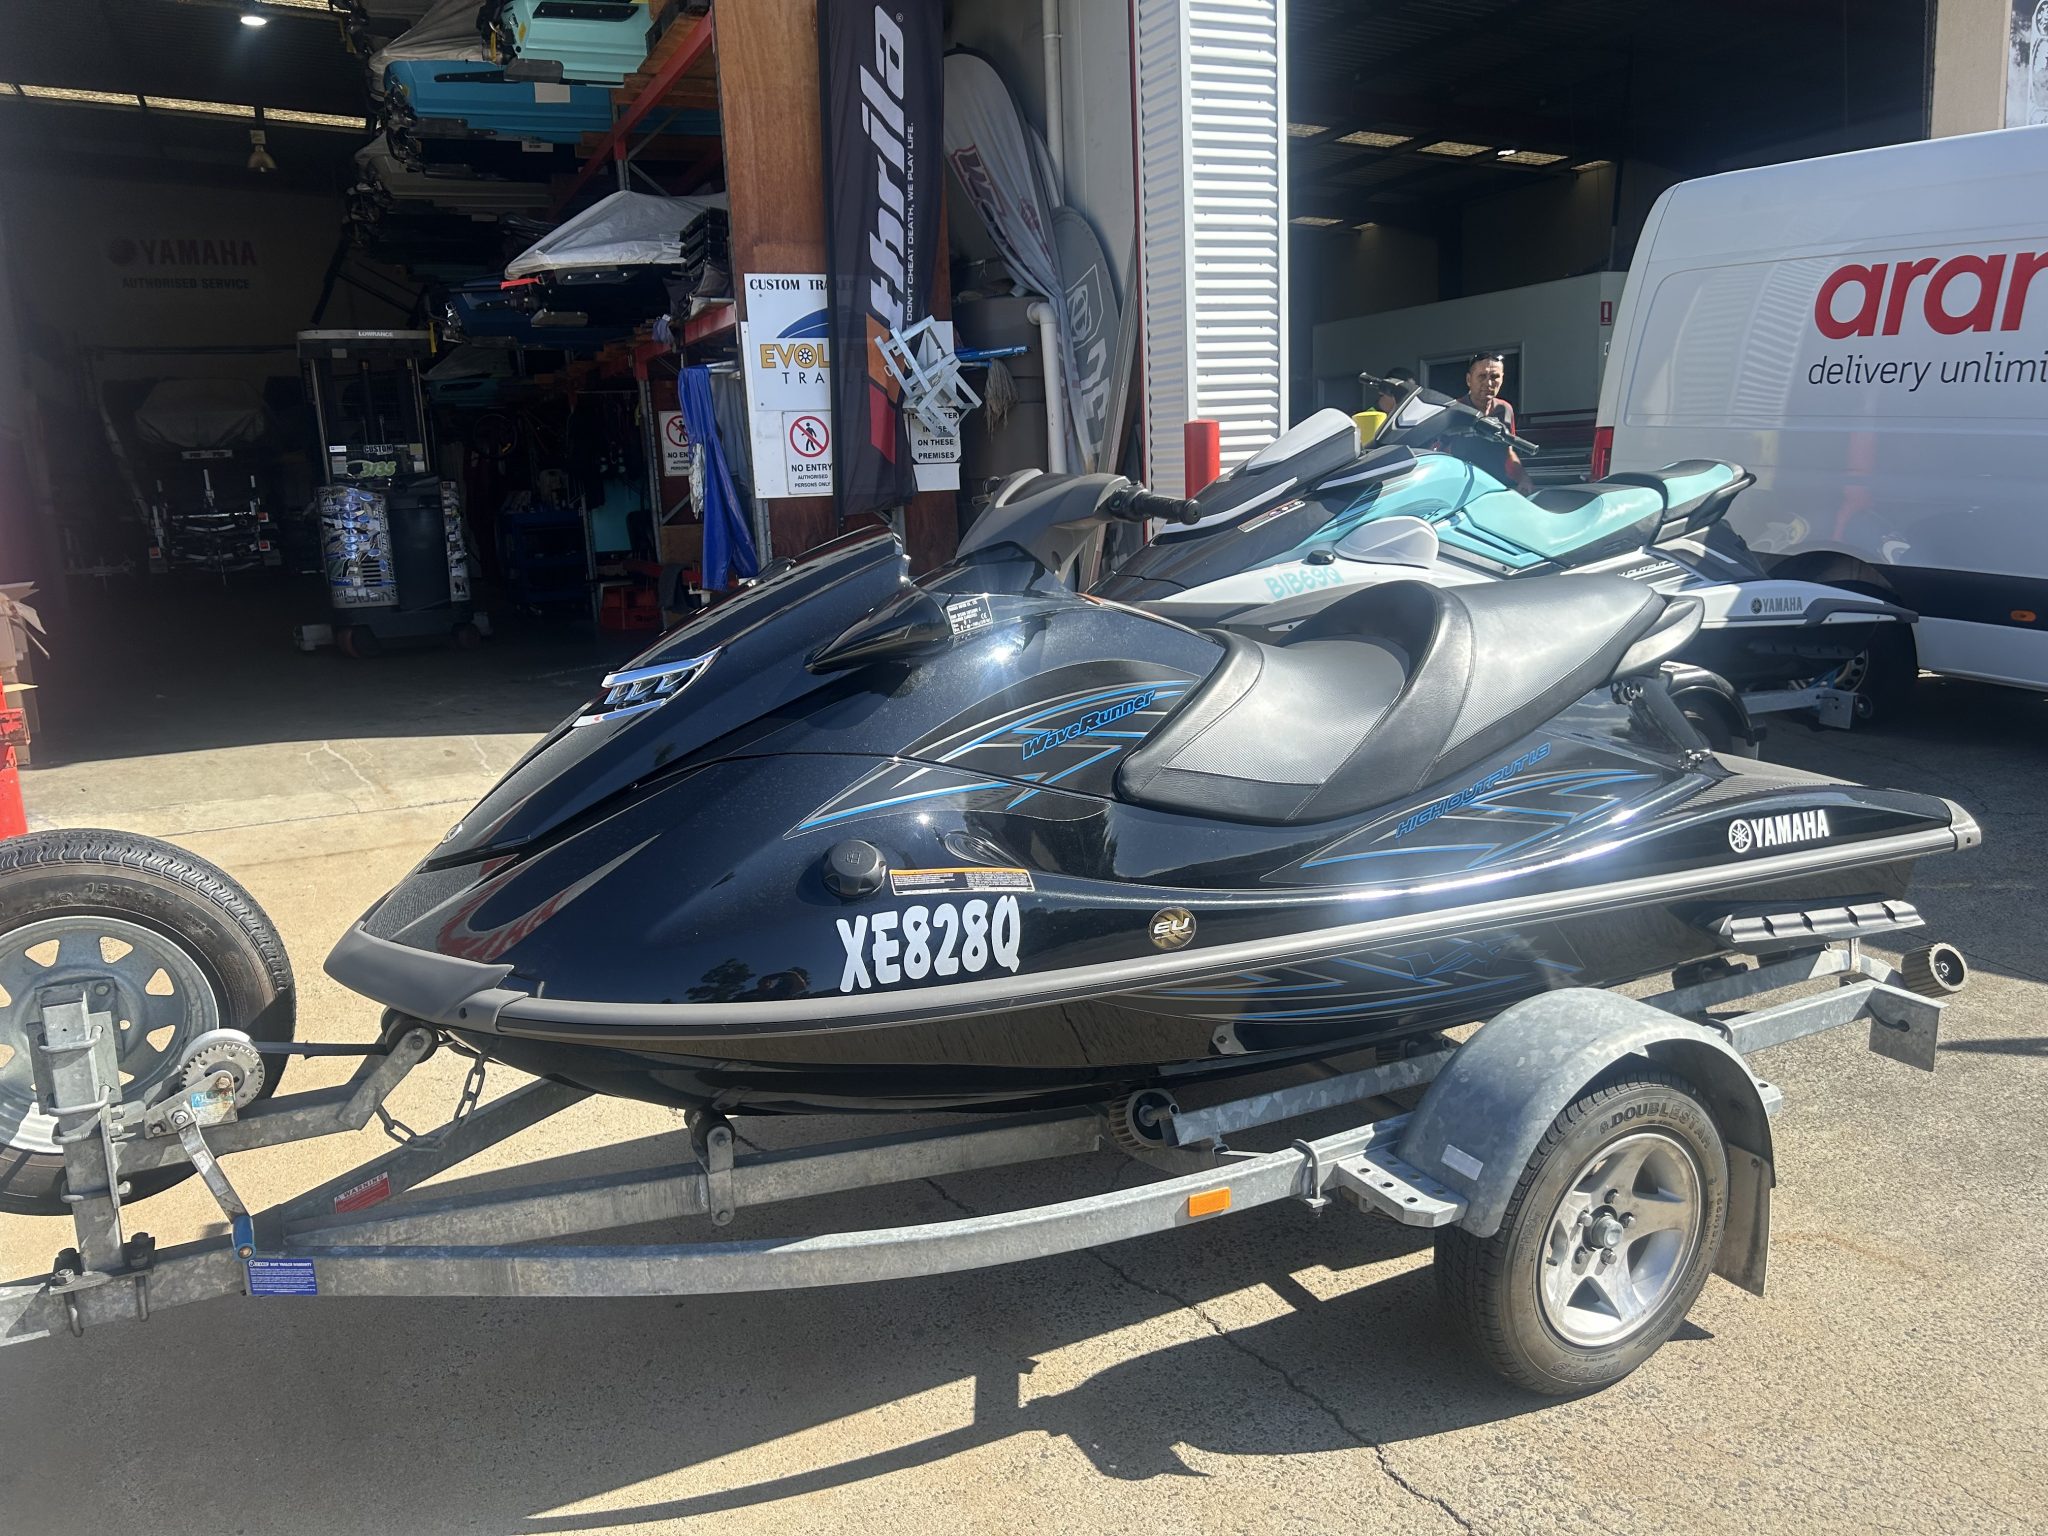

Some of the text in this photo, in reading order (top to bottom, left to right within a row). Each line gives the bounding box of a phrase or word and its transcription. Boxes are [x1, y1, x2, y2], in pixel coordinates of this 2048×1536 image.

[860, 5, 905, 334] thrila
[907, 183, 914, 201] WE
[907, 204, 915, 244] DEATH,
[140, 239, 257, 266] YAMAHA
[122, 278, 250, 289] AUTHORISED SERVICE
[749, 279, 800, 291] CUSTOM
[906, 287, 914, 322] DON'T
[760, 343, 831, 369] EVOL
[782, 371, 826, 385] TRA
[1808, 355, 1932, 393] delivery
[930, 438, 955, 446] THESE
[667, 451, 678, 459] NO
[918, 451, 955, 460] PREMISES
[791, 462, 833, 473] NO ENTRY
[1762, 597, 1804, 613] YAMAHA
[1022, 689, 1157, 761] WaveRunner
[1750, 808, 1830, 848] YAMAHA
[1153, 917, 1190, 934] EU
[836, 894, 1021, 992] XE828Q
[1609, 1101, 1711, 1149] DOUBLESTAR
[343, 1174, 385, 1197] WARNING
